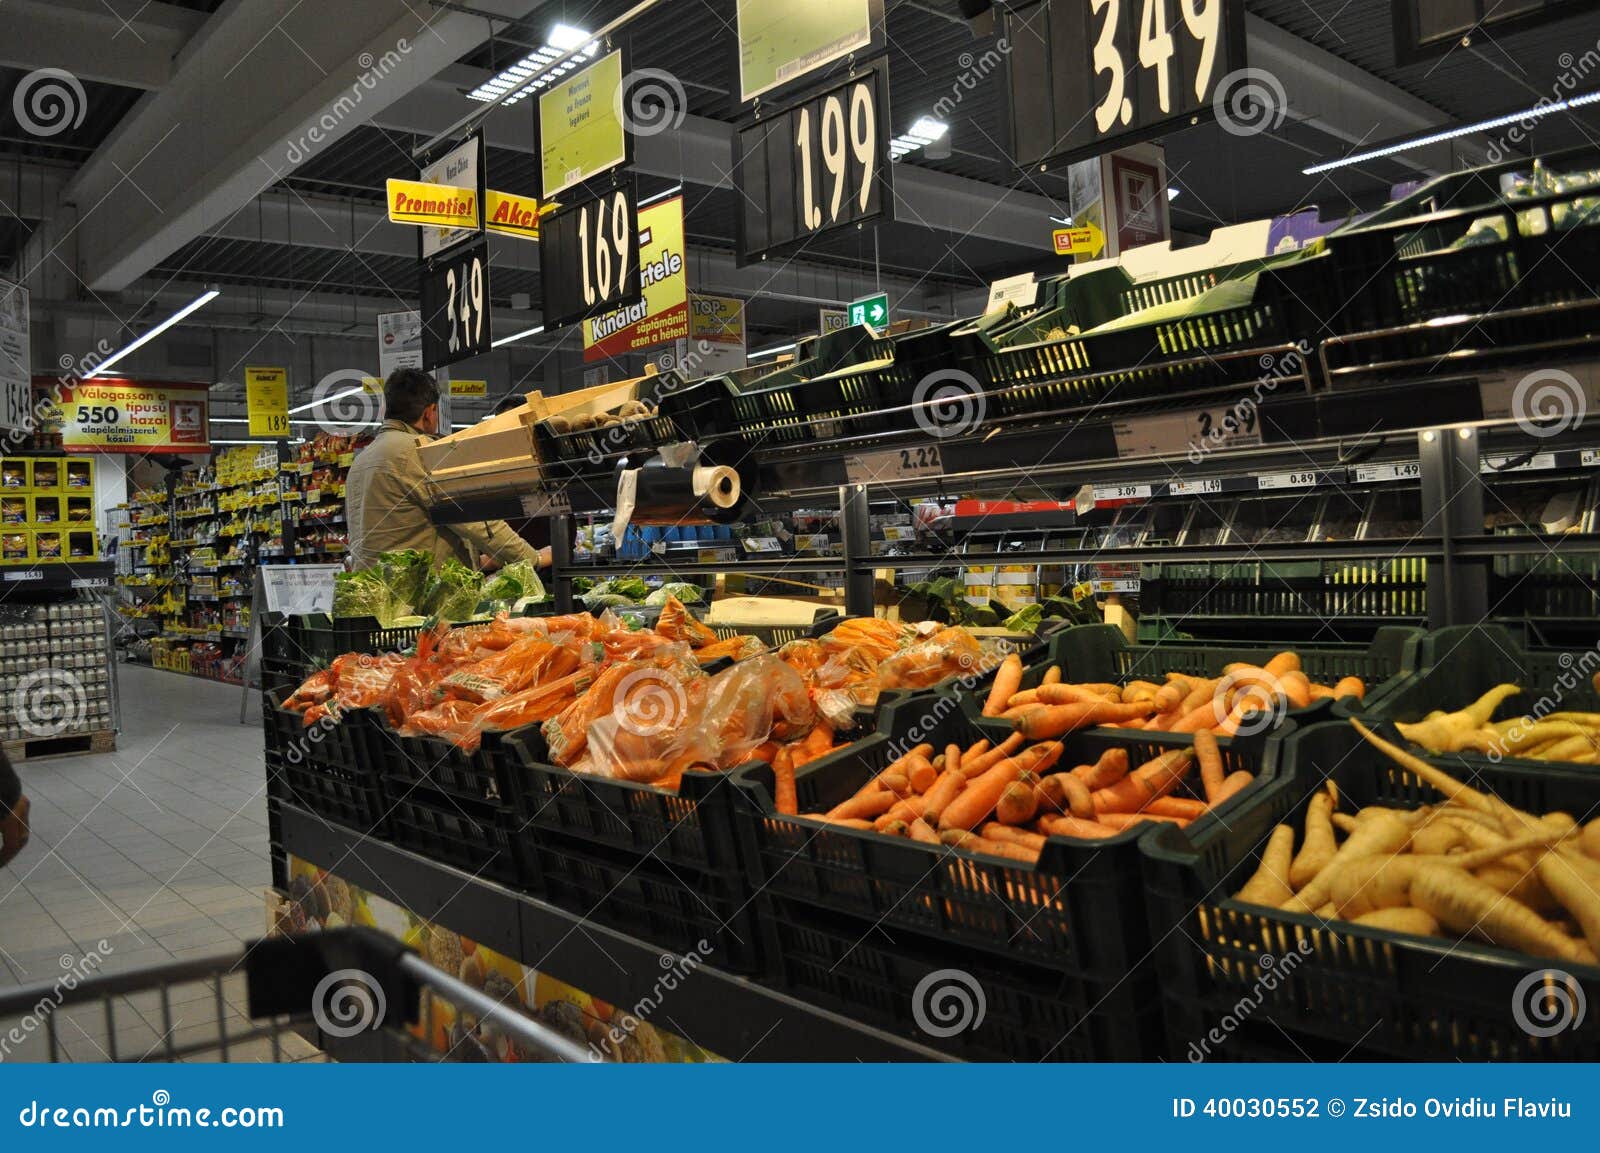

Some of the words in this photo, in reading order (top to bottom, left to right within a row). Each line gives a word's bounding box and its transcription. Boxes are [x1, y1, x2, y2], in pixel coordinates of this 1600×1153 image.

[1090, 0, 1219, 134] 3.49
[797, 84, 876, 231] 1.99
[579, 191, 629, 306] 1.69
[447, 258, 482, 353] 3.49
[78, 388, 154, 401] Válogasson
[77, 406, 119, 424] 550
[130, 414, 168, 426] hazai
[900, 446, 940, 470] 2.22
[1394, 463, 1419, 477] 1.49
[1203, 479, 1220, 492] 1.49
[1290, 473, 1314, 484] 0.89
[1117, 486, 1137, 497] 3.09
